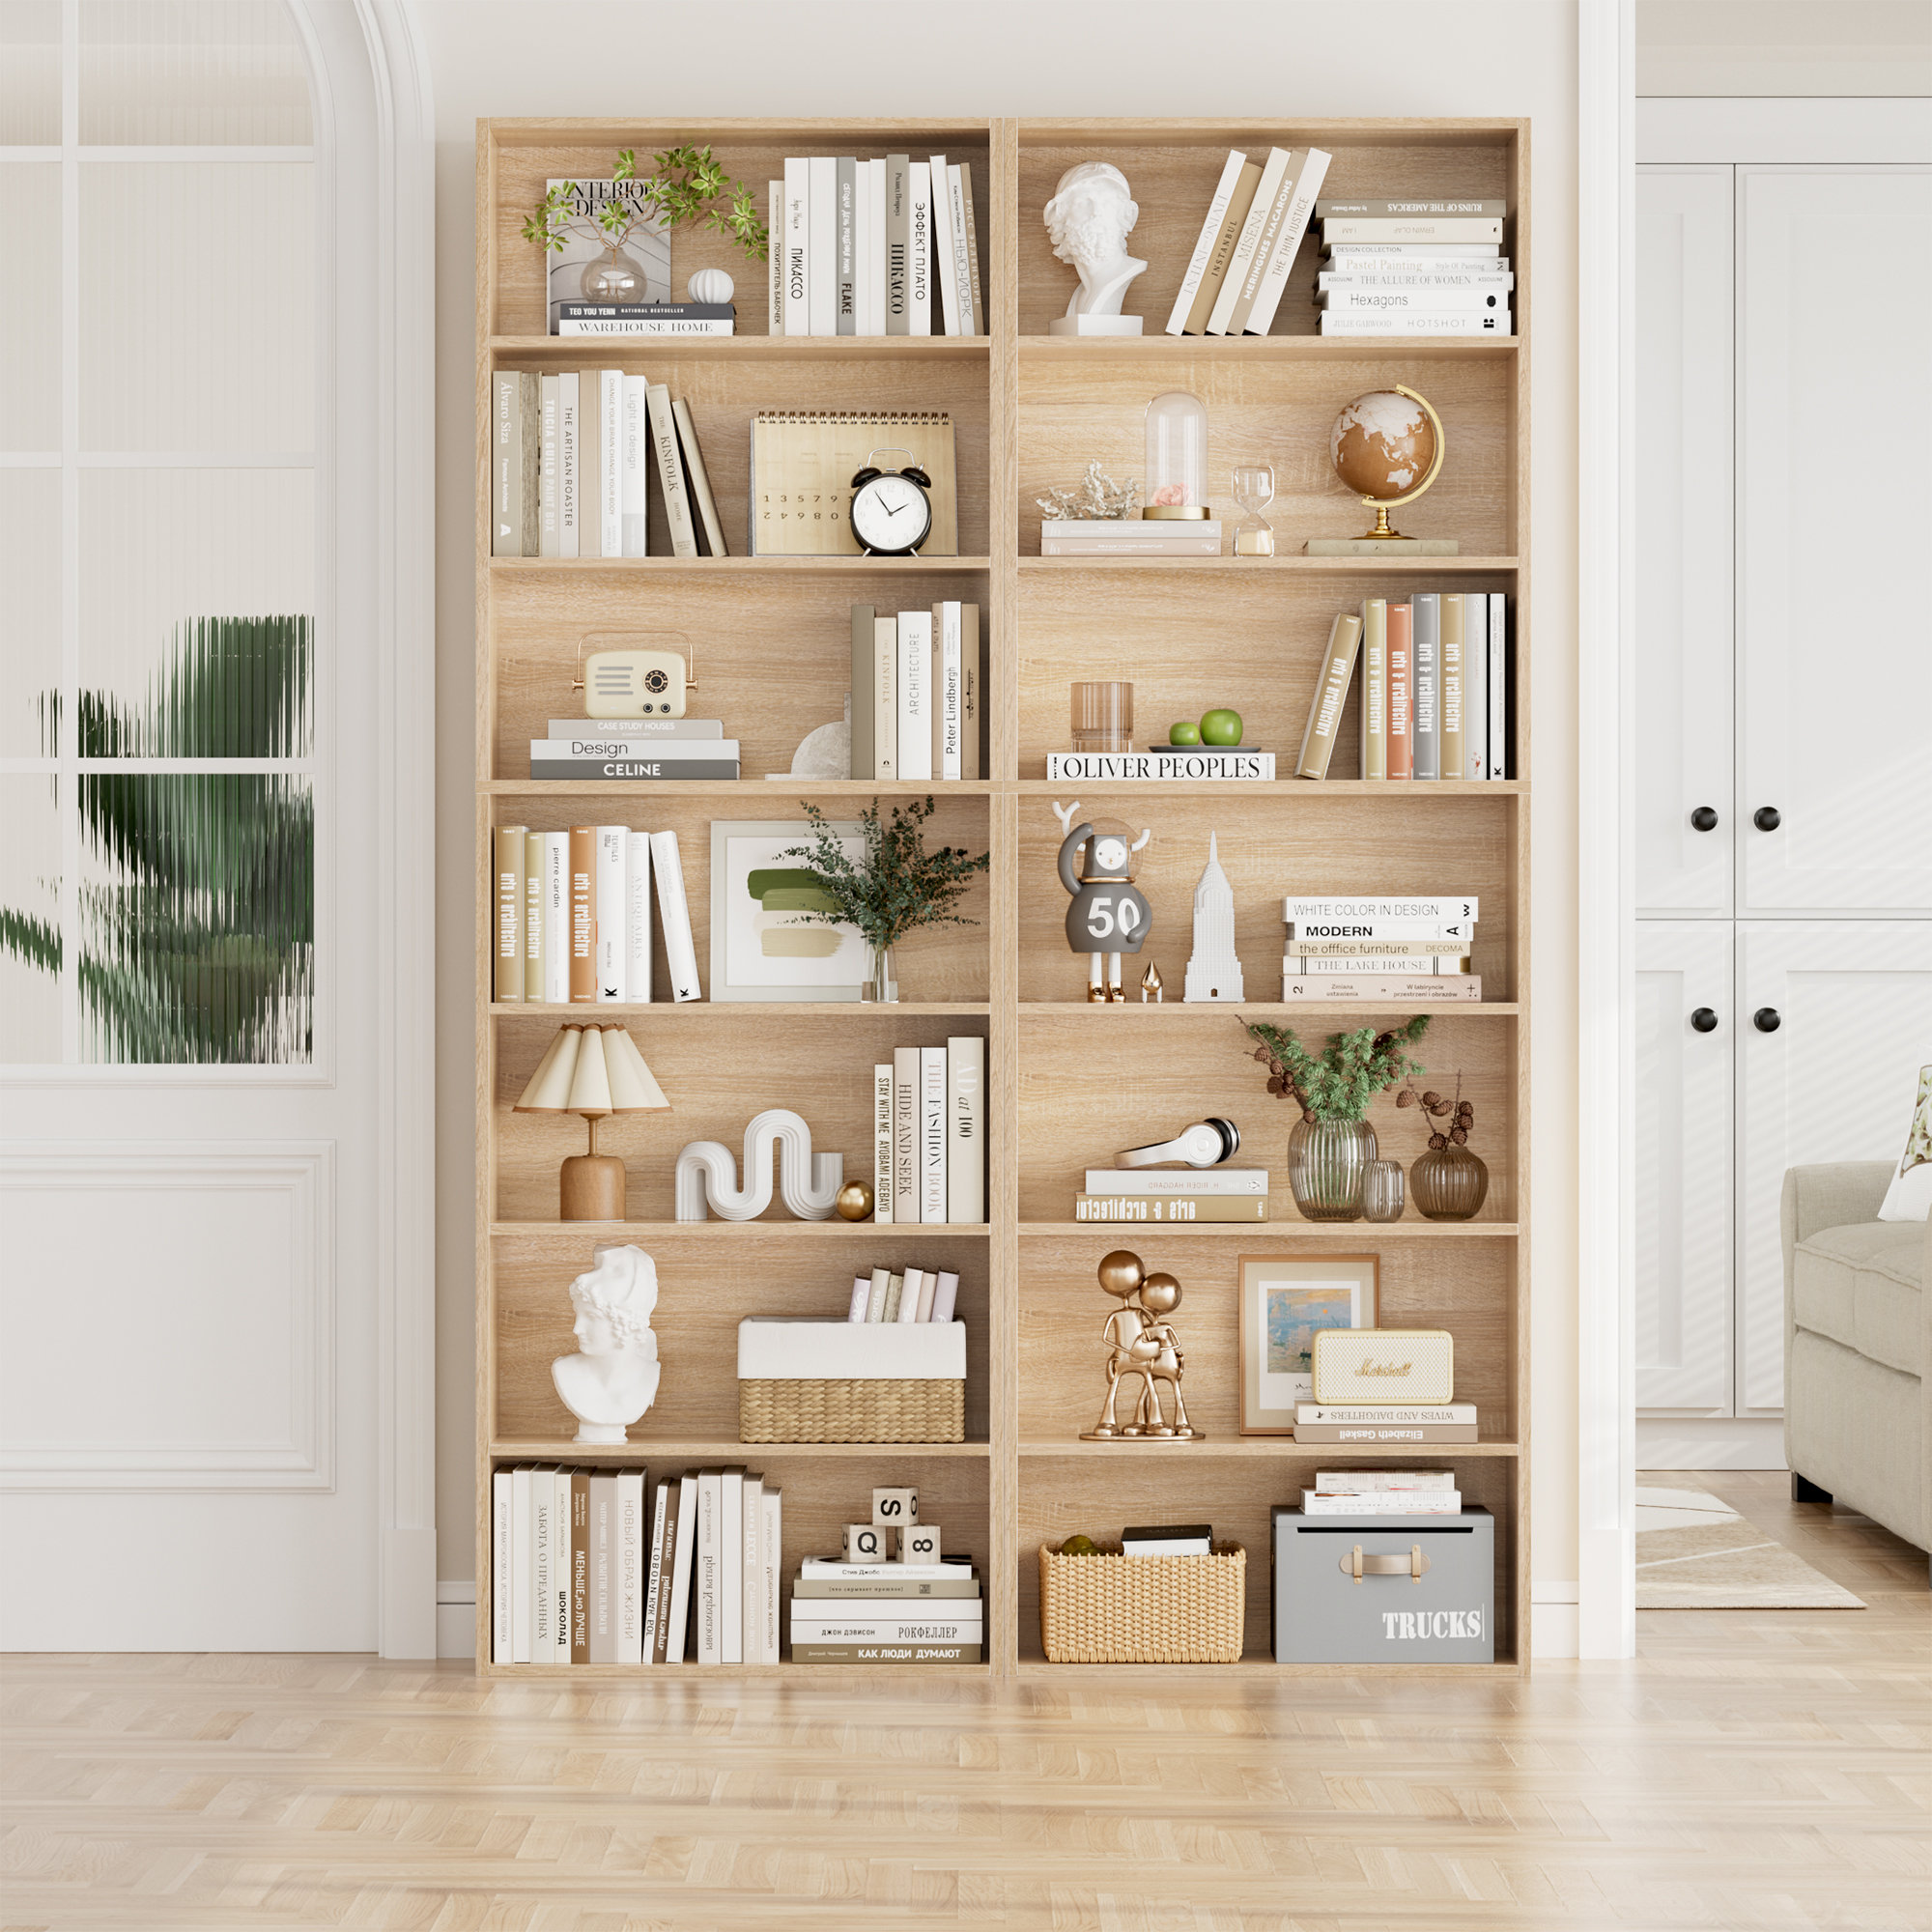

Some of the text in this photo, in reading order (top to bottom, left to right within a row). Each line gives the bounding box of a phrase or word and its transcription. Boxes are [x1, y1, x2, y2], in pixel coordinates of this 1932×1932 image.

[1387, 203, 1483, 213] RUINS OF THE AMERICAS
[915, 203, 925, 300] ЭФФЕКТ ПЛАТО
[1210, 220, 1237, 277] INSTANBUL
[1243, 179, 1293, 300] MERINGUES MACARONS
[790, 248, 804, 299] ПИКАССО
[891, 243, 904, 314] ПИКАССО
[1272, 258, 1286, 276] THE
[1346, 259, 1423, 272] Pastel Painting
[1360, 275, 1471, 285] THE ALLURE OF WOMEN
[841, 283, 852, 315] FLAKE
[1350, 294, 1408, 309] Hexagons
[579, 323, 713, 332] WAREHOUSE HOME
[500, 381, 514, 444] Álvaro Siza
[544, 399, 555, 438] TRICIA
[627, 393, 639, 469] Light in design
[544, 441, 555, 476] GUILD
[564, 407, 573, 526] THE ARTISAN ROASTER
[660, 436, 679, 492] KINFOLK
[909, 633, 920, 716] ARCHITECTURE
[946, 667, 958, 720] Lindbergh
[572, 741, 628, 759] Design
[946, 724, 956, 754] Peter
[603, 763, 661, 777] CELINE
[1064, 757, 1151, 779] OLIVER
[1159, 757, 1261, 779] PEOPLES
[1087, 896, 1140, 939] 50
[1293, 904, 1439, 916] WHITE COLOR IN DESIGN
[1306, 926, 1373, 937] MODERN
[1299, 944, 1318, 954] the
[1359, 944, 1409, 954] furniture
[1314, 960, 1427, 970] THE LAKE HOUSE
[956, 1060, 978, 1138] AD at 100
[878, 1077, 890, 1213] STAY WITH ME AYOBAMI ADEBAYO
[898, 1084, 912, 1196] HIDE AND SEEK
[927, 1063, 942, 1213] THE FASHION BOOK
[1330, 1410, 1455, 1420] WIVES AND DAUGHTERS
[1339, 1430, 1424, 1439] Elizabeth Gaskell
[880, 1498, 901, 1517] S
[538, 1504, 548, 1549] ЗАБОТА
[857, 1531, 878, 1555] Q
[912, 1538, 933, 1552] 8
[624, 1499, 636, 1639] НОВЫЙ ОБРАЗ ЖИЗНИ
[537, 1564, 548, 1640] ПРЕДАННЫХ
[557, 1591, 567, 1646] ШОКОЛАД
[575, 1610, 585, 1647] ЛУЧШЕ
[898, 1627, 957, 1639] РОКФЕЛЛЕР
[1382, 1609, 1481, 1639] TRUCKS
[858, 1649, 878, 1658] КАК
[880, 1649, 913, 1659] ЛЮДИ
[915, 1649, 962, 1659] ДУМАЮТ
